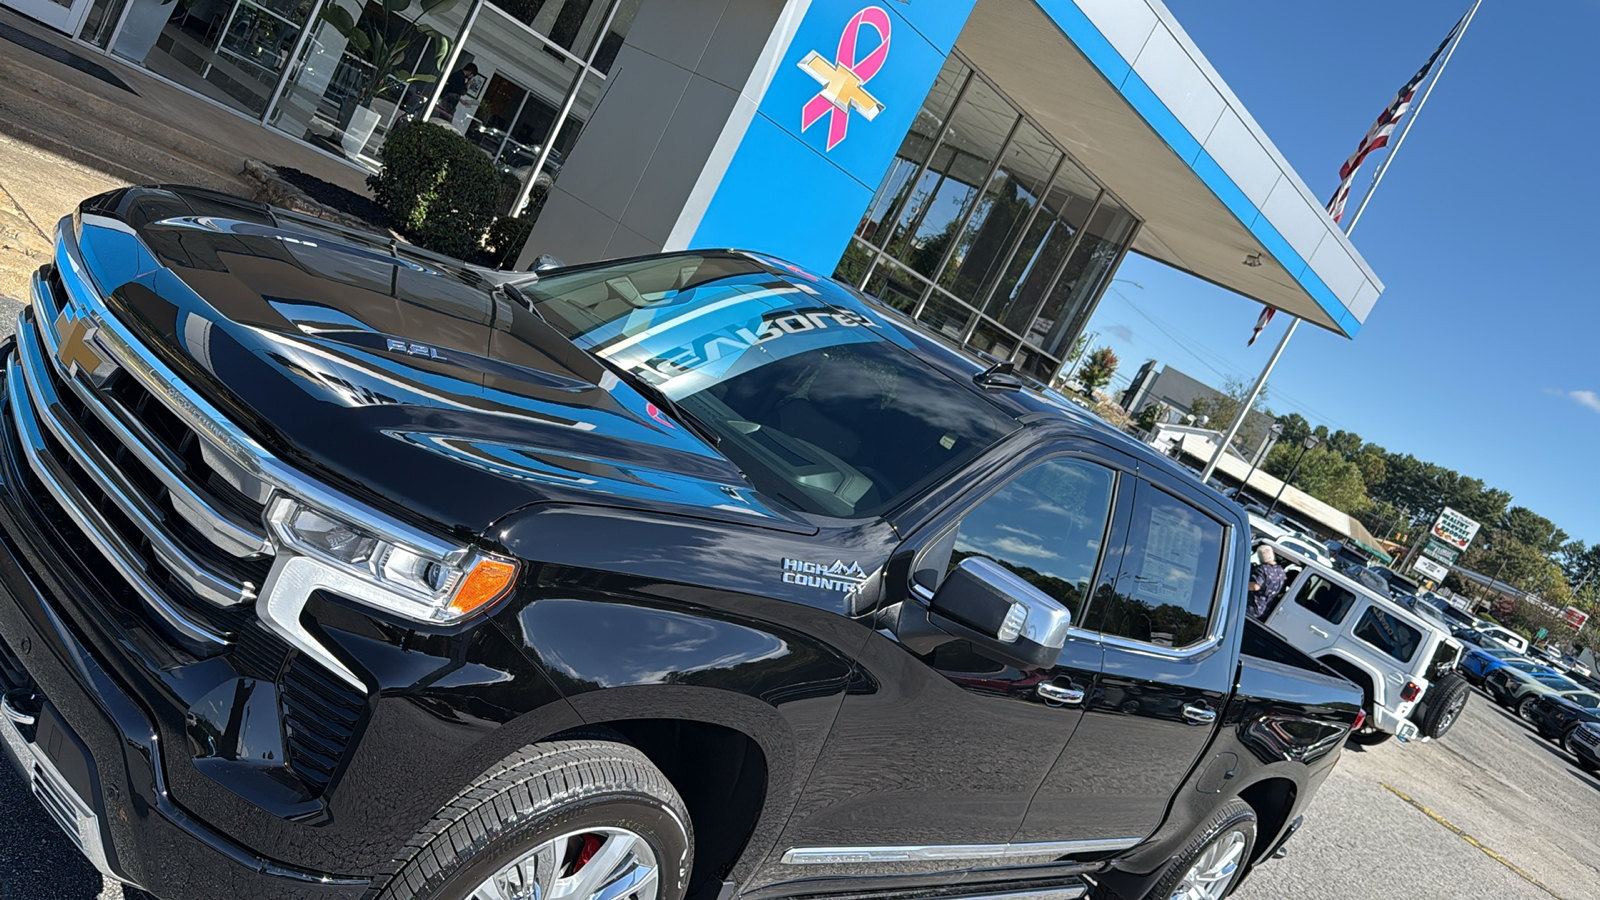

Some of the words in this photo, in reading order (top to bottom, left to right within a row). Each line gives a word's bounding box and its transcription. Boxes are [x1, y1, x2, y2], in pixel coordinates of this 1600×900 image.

[1441, 512, 1470, 530] HEALTHY
[1441, 519, 1471, 537] HARVEST
[782, 558, 828, 576] HIGH
[782, 572, 866, 595] COUNTRY
